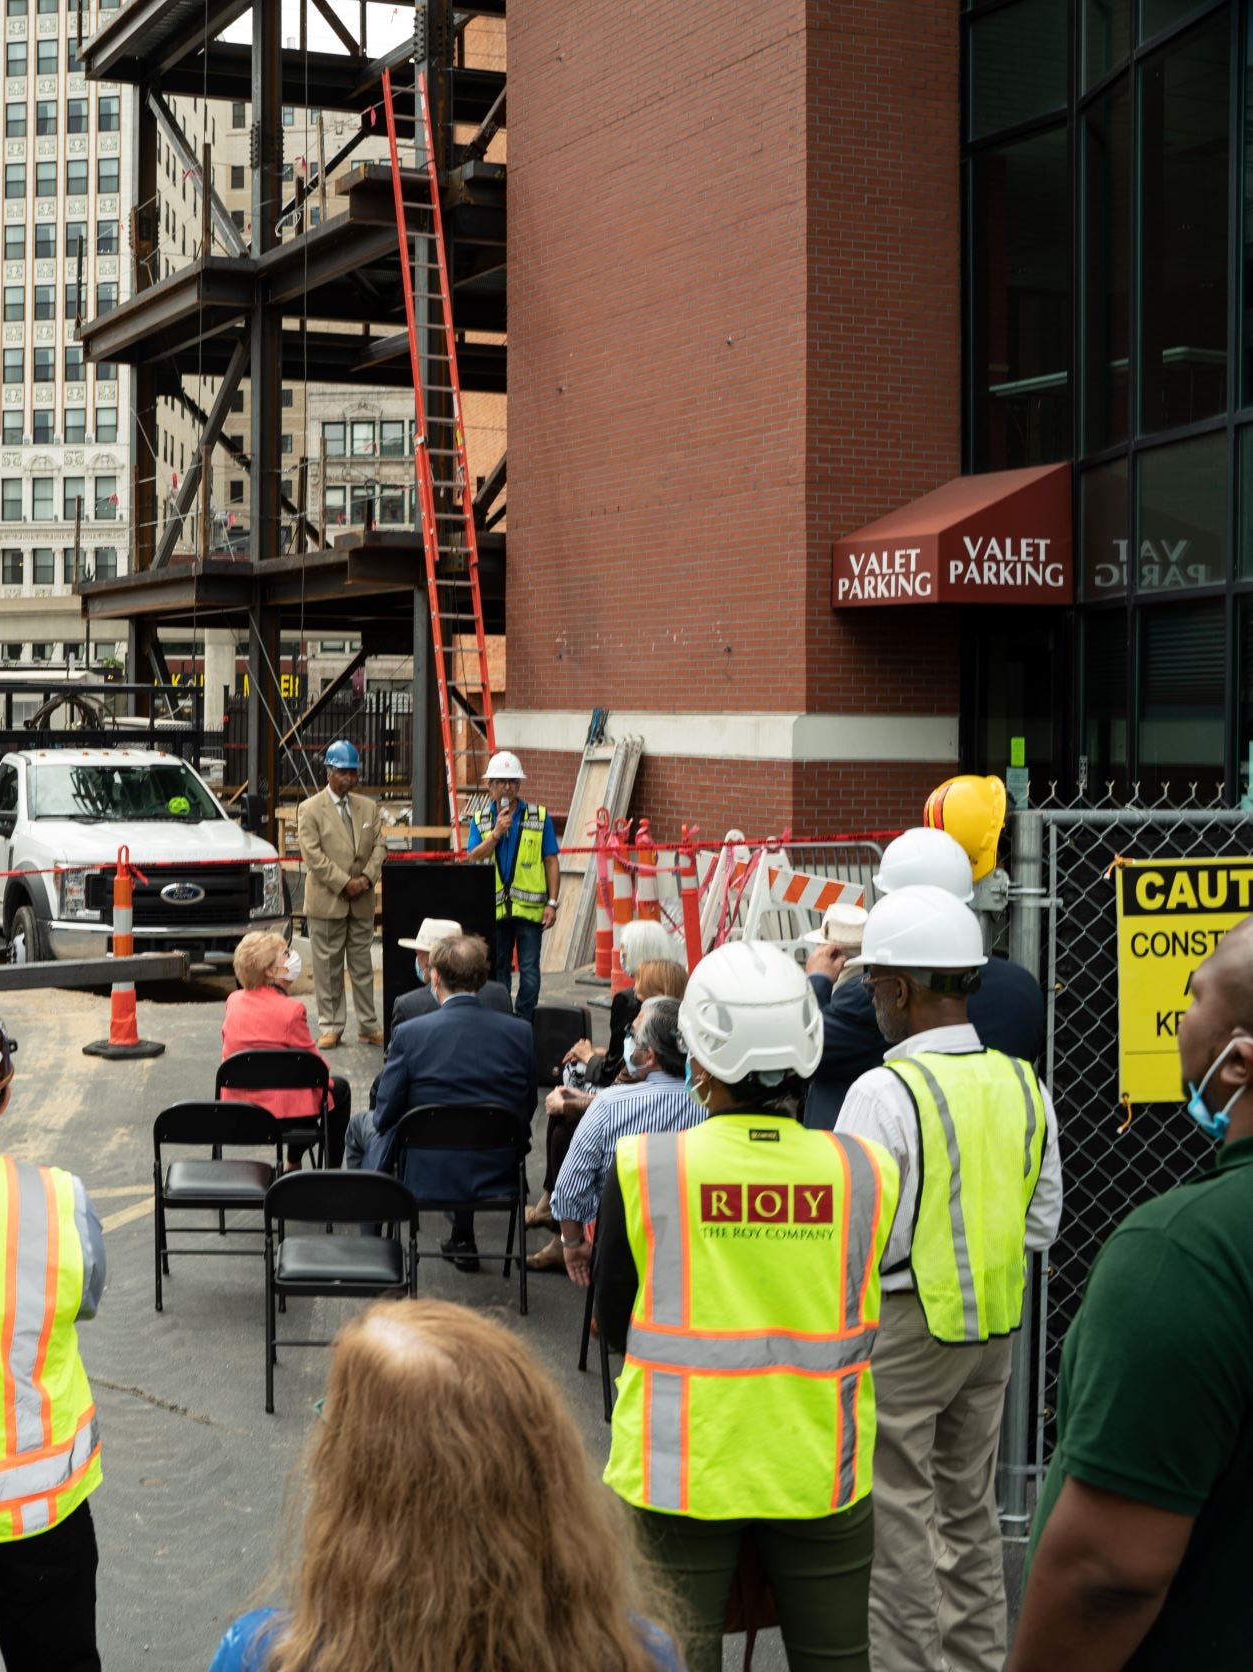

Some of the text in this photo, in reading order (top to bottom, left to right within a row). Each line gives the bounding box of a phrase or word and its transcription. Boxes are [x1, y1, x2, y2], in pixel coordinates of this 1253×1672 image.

[849, 549, 921, 577] VALET
[963, 536, 1051, 562] VALET
[838, 572, 932, 601] PARKING
[949, 560, 1064, 588] PARKING
[1131, 929, 1229, 958] CONST
[711, 1190, 826, 1218] ROY
[702, 1227, 835, 1241] THE ROY COMPANY
